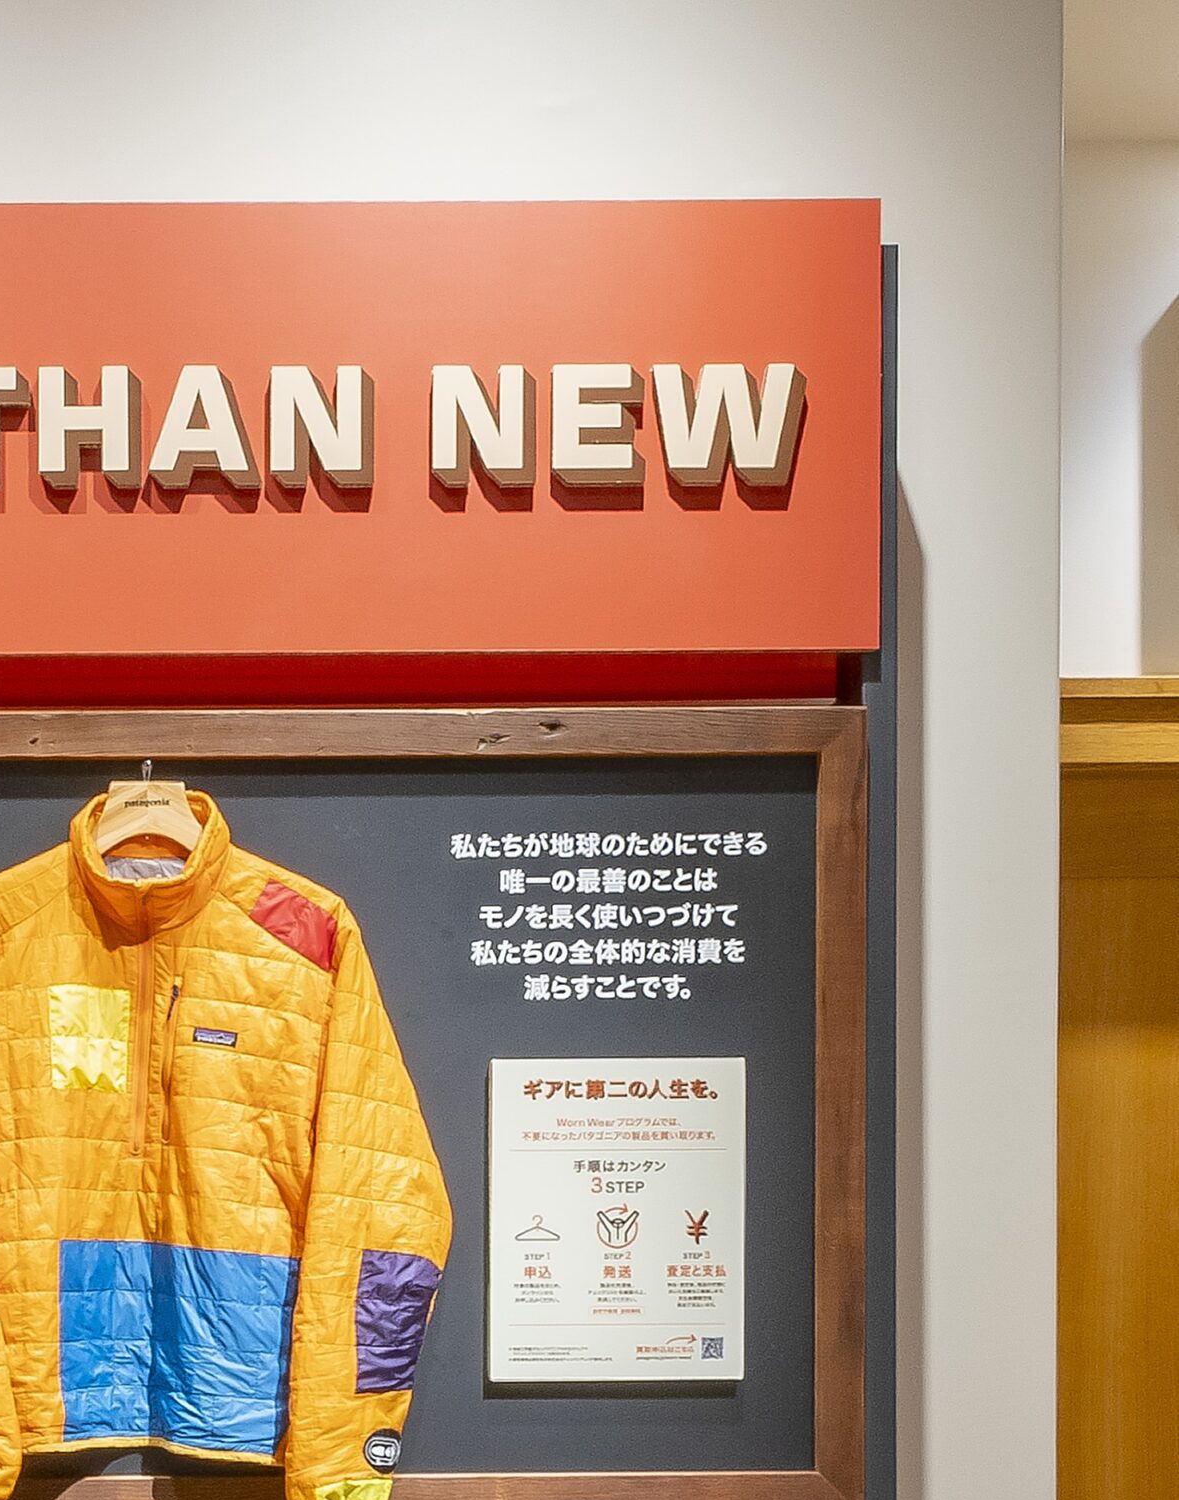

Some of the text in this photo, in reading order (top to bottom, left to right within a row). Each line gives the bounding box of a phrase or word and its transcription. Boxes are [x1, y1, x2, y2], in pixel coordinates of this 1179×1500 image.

[432, 363, 804, 487] NEW
[450, 832, 768, 859] 私たちが地球のためにできる
[499, 868, 718, 895] 唯一の最善のことは
[479, 902, 739, 929] モノを長く使いつづけて
[470, 938, 747, 966] 私たちの全体的な消費を
[523, 974, 692, 1000] 減らすことです。
[523, 1079, 718, 1100] ギアに第二の人生を。
[573, 1160, 666, 1173] 手順はカンタン
[591, 1176, 645, 1193] 3 STEP
